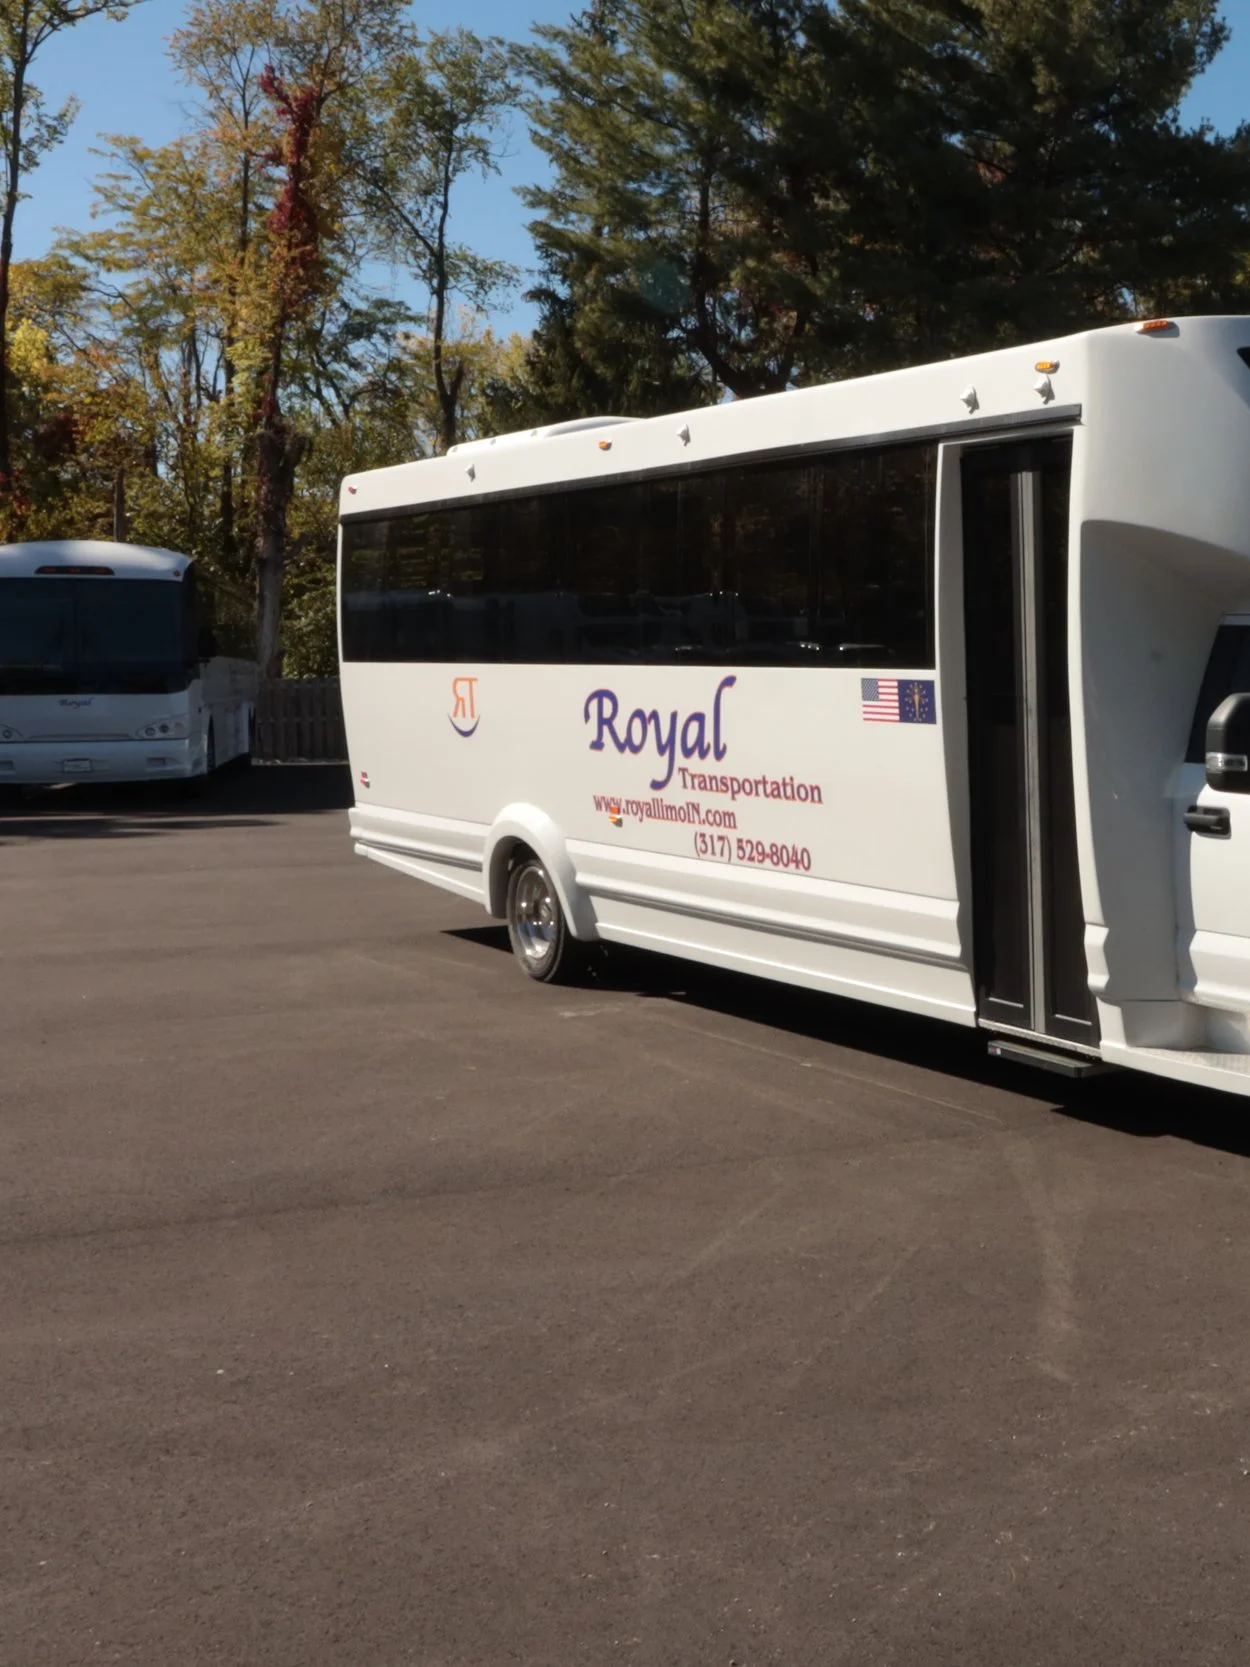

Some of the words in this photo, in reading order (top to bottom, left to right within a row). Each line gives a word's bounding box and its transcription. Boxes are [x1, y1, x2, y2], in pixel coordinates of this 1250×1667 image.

[584, 675, 737, 791] Royal
[678, 767, 824, 805] Transportation
[694, 831, 732, 863] (317)
[736, 838, 812, 872] 529-8040
